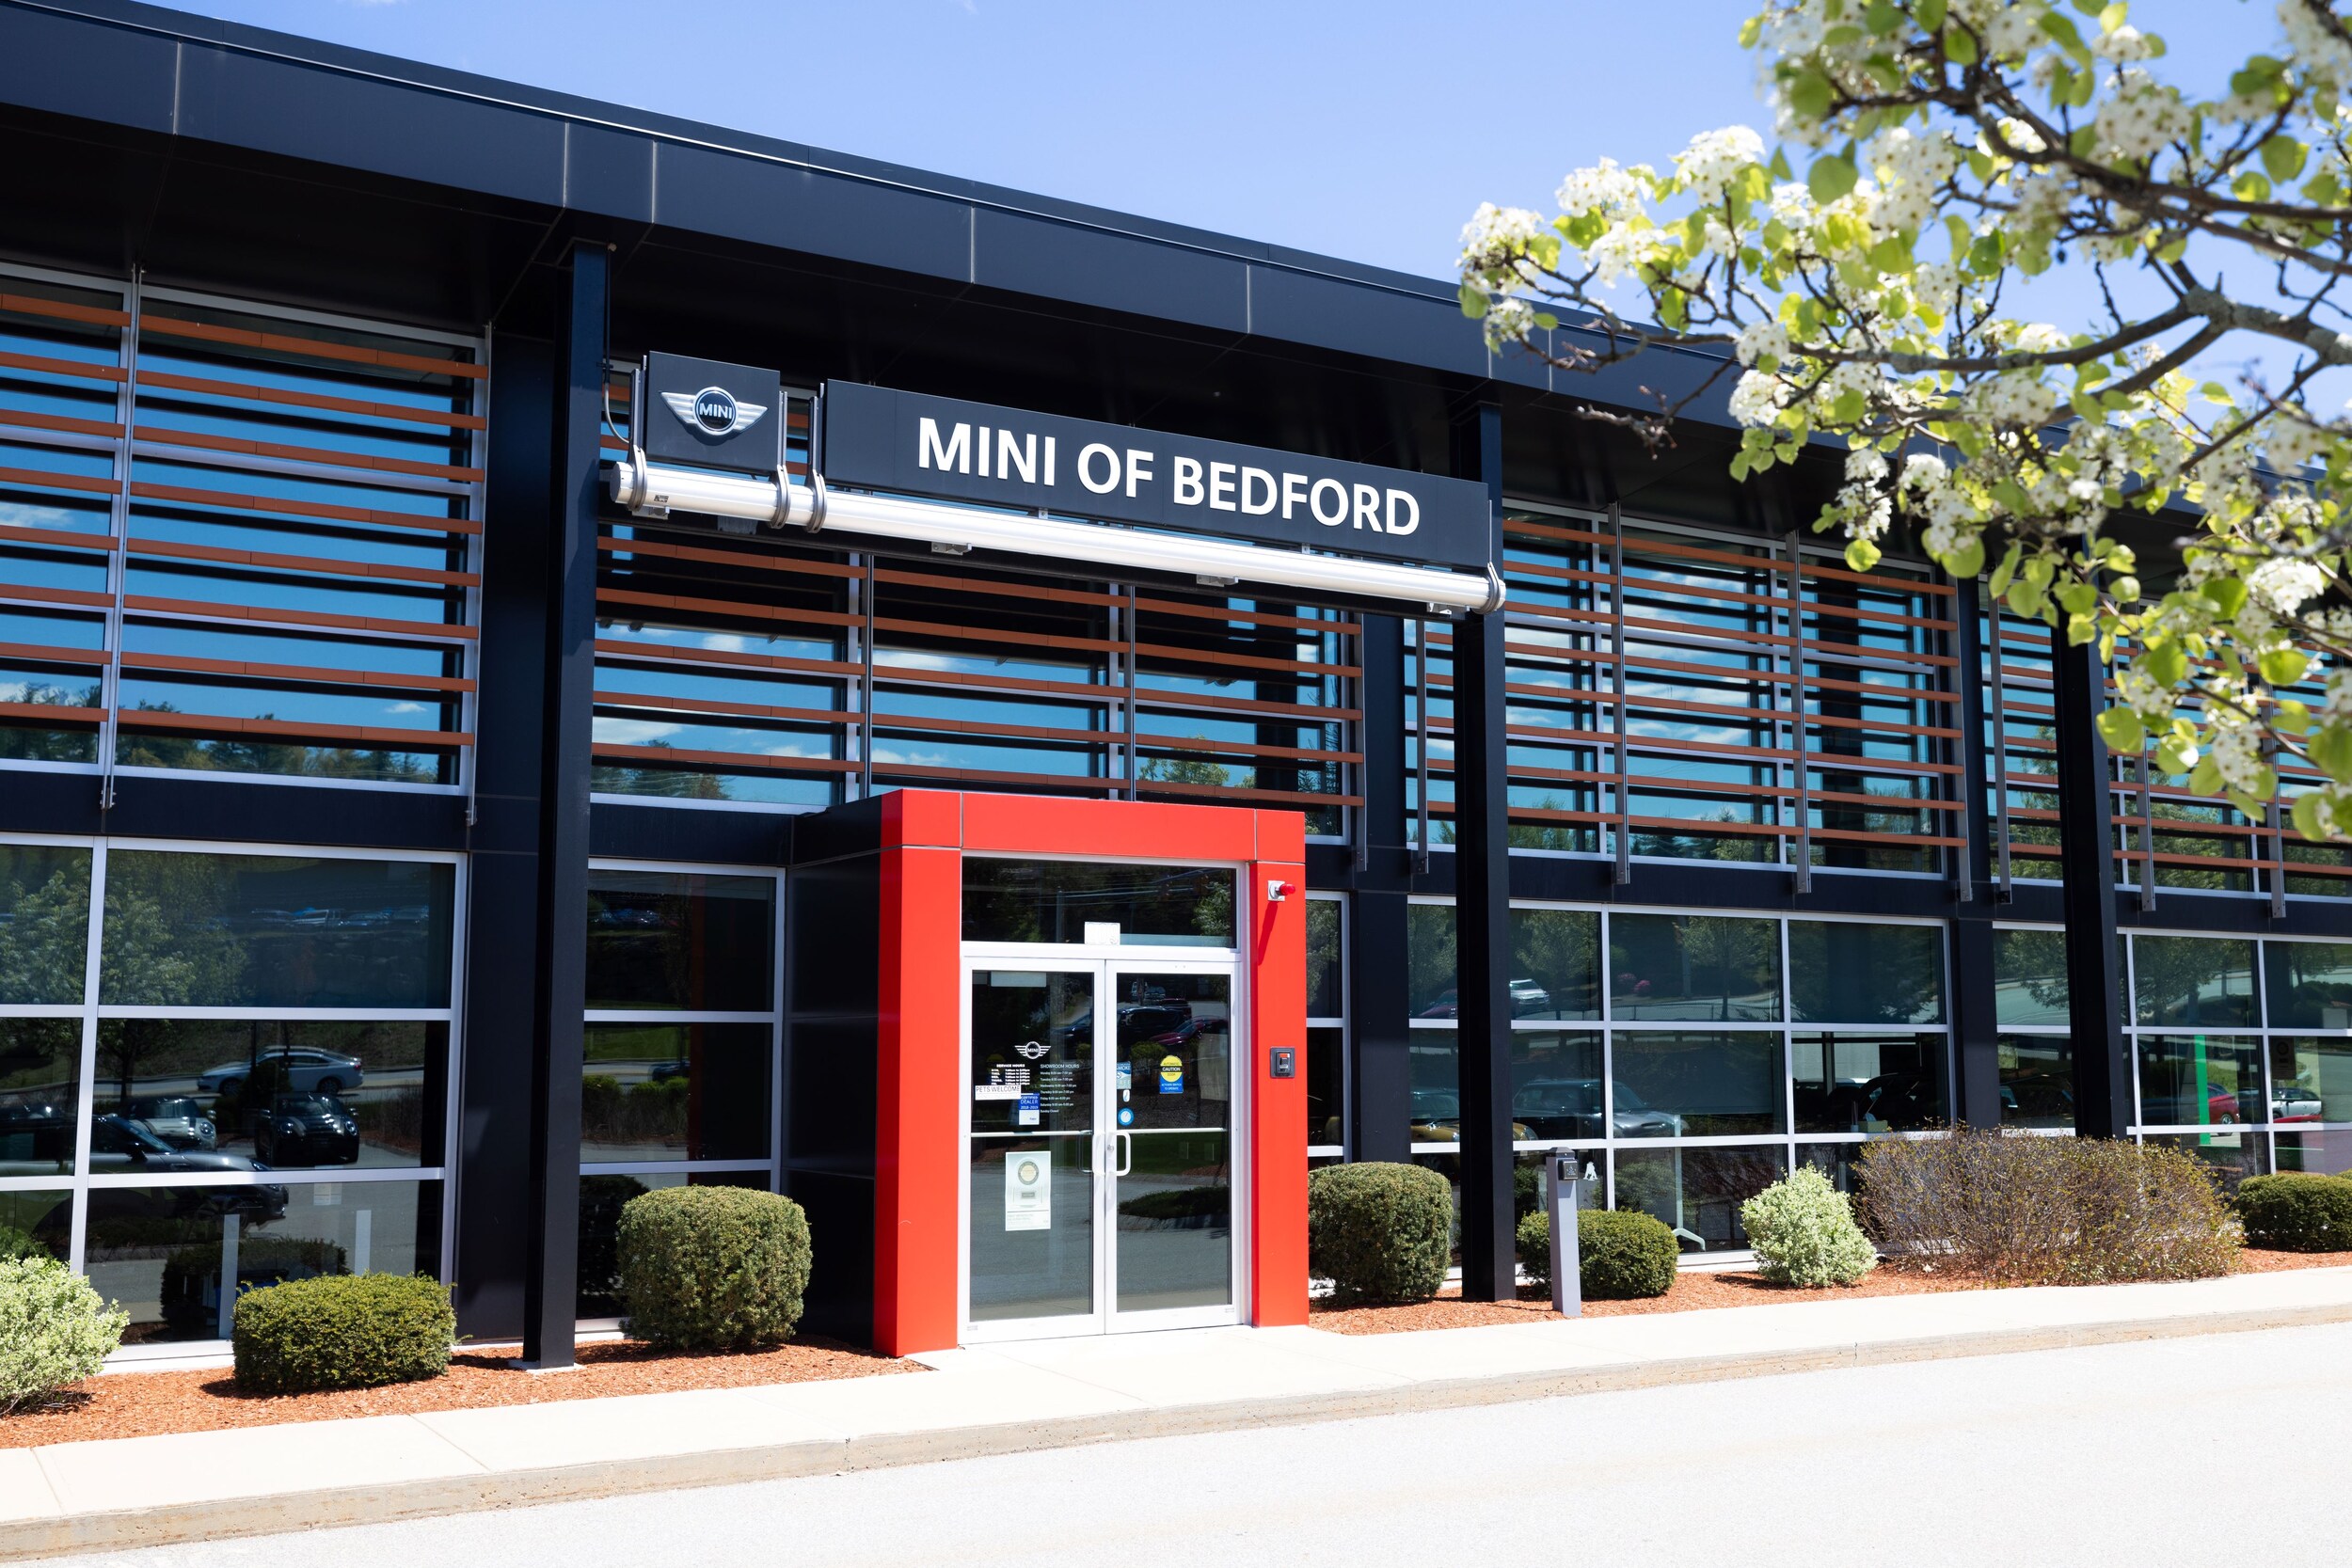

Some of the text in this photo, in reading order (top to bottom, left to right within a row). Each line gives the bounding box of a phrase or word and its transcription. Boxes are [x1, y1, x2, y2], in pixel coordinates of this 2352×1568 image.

[699, 403, 733, 420] MINI
[918, 417, 1420, 536] MINI OF BEDFORD
